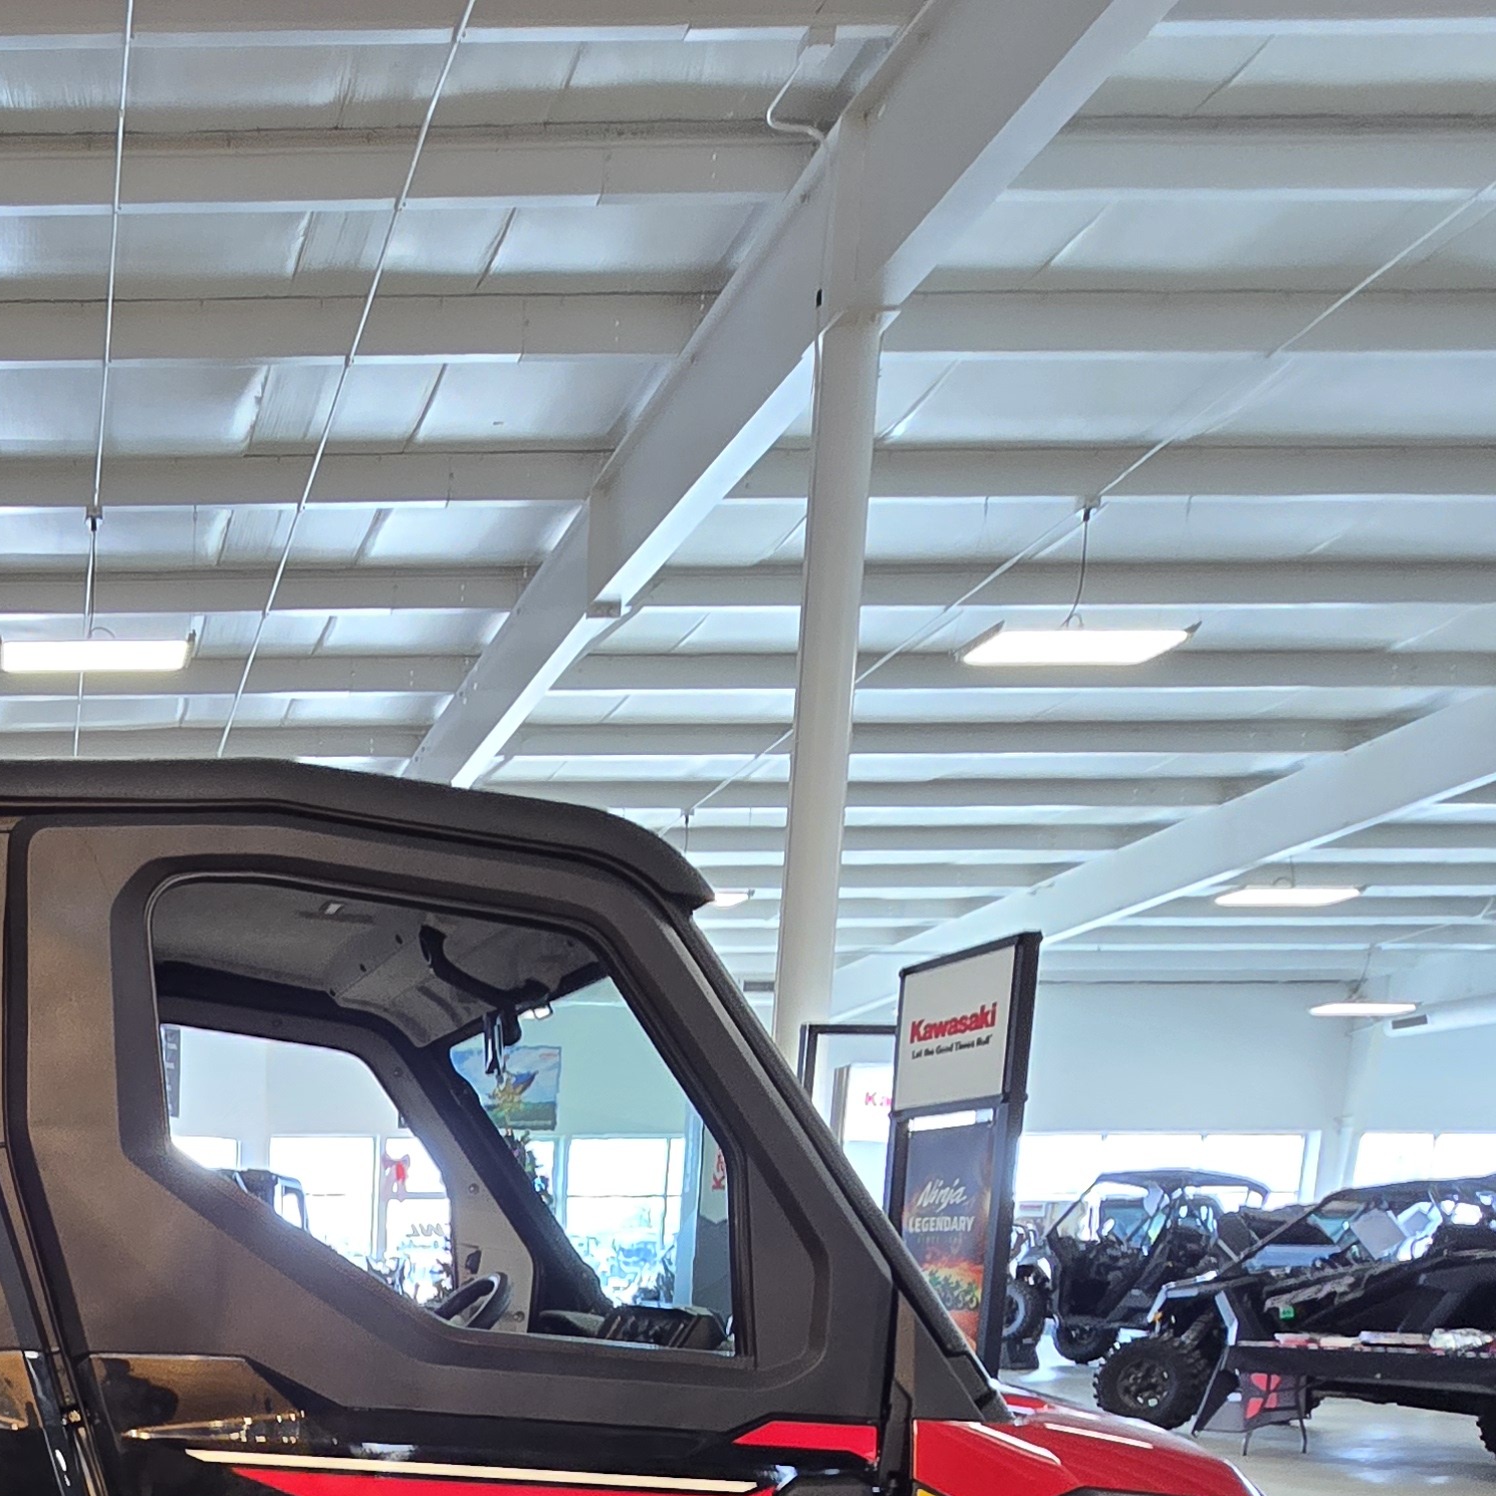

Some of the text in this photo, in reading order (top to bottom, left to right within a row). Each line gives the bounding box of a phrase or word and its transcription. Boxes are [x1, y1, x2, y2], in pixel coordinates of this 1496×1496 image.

[910, 1002, 997, 1043] Kawasaki
[917, 1178, 967, 1212] Ninja
[909, 1216, 975, 1233] LEGENDARY
